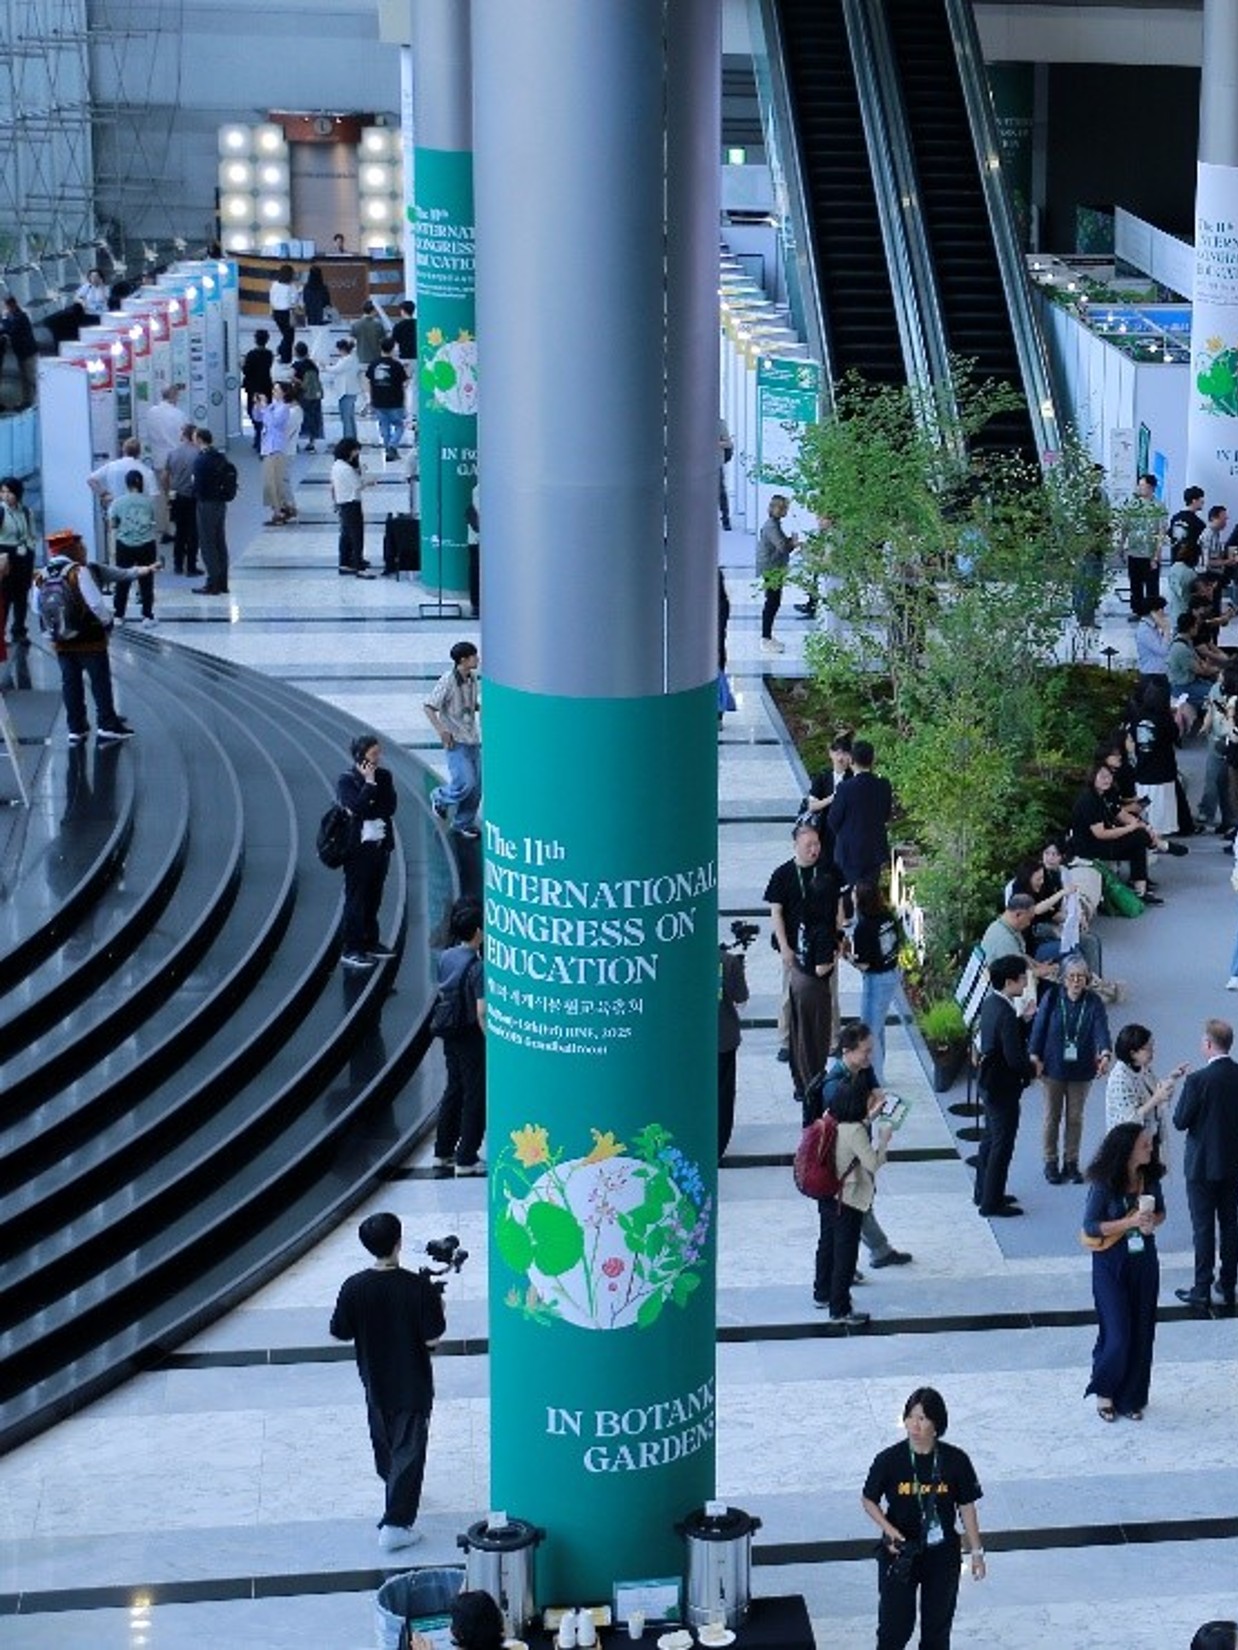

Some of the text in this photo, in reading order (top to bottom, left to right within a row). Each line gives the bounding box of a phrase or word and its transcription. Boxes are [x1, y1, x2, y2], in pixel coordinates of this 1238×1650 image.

[485, 820, 566, 866] The 11th
[485, 857, 717, 910] INTERNATIONAL
[485, 898, 697, 947] CONGRESS ON
[486, 932, 660, 985] EDUCATION
[545, 1405, 584, 1438] IN
